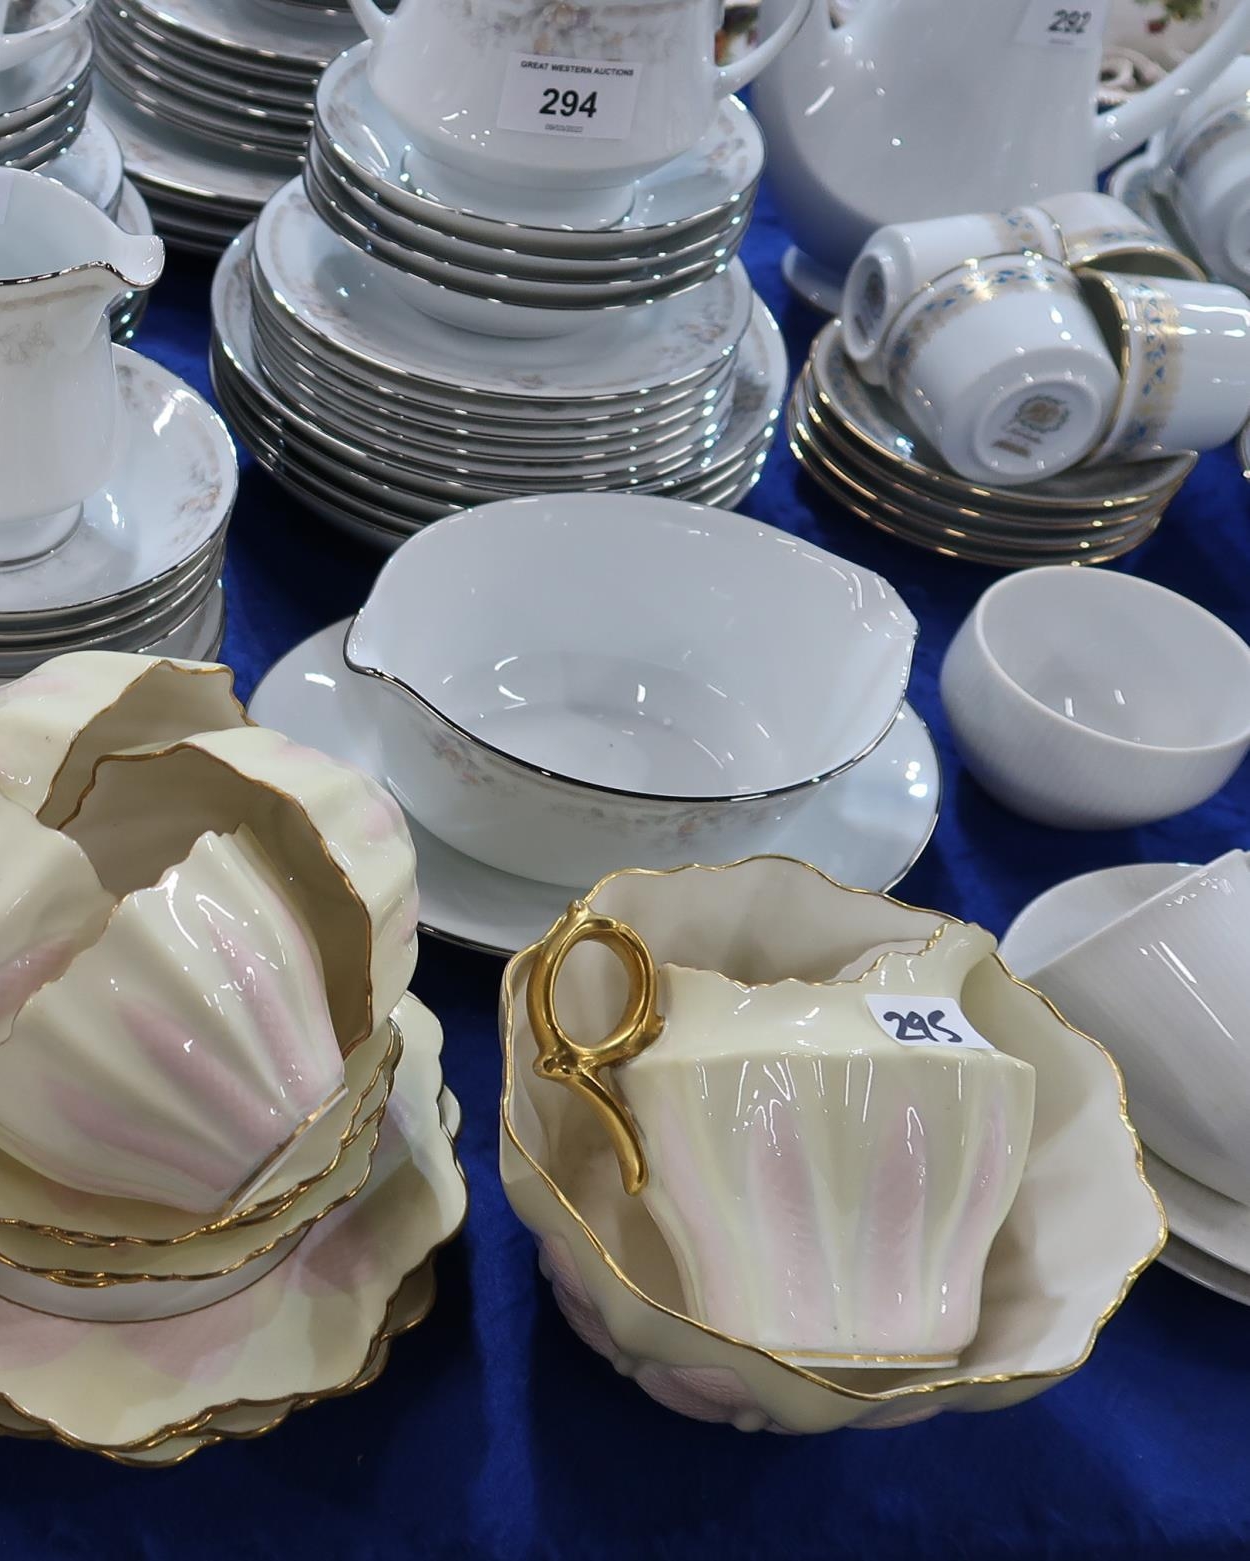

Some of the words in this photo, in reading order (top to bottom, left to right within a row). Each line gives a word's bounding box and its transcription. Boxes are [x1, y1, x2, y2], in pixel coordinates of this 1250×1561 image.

[521, 60, 549, 70] GREAT
[551, 63, 592, 74] WESTERN
[594, 67, 634, 77] AUCTIONS
[539, 88, 598, 118] 294
[883, 1009, 963, 1043] 295
